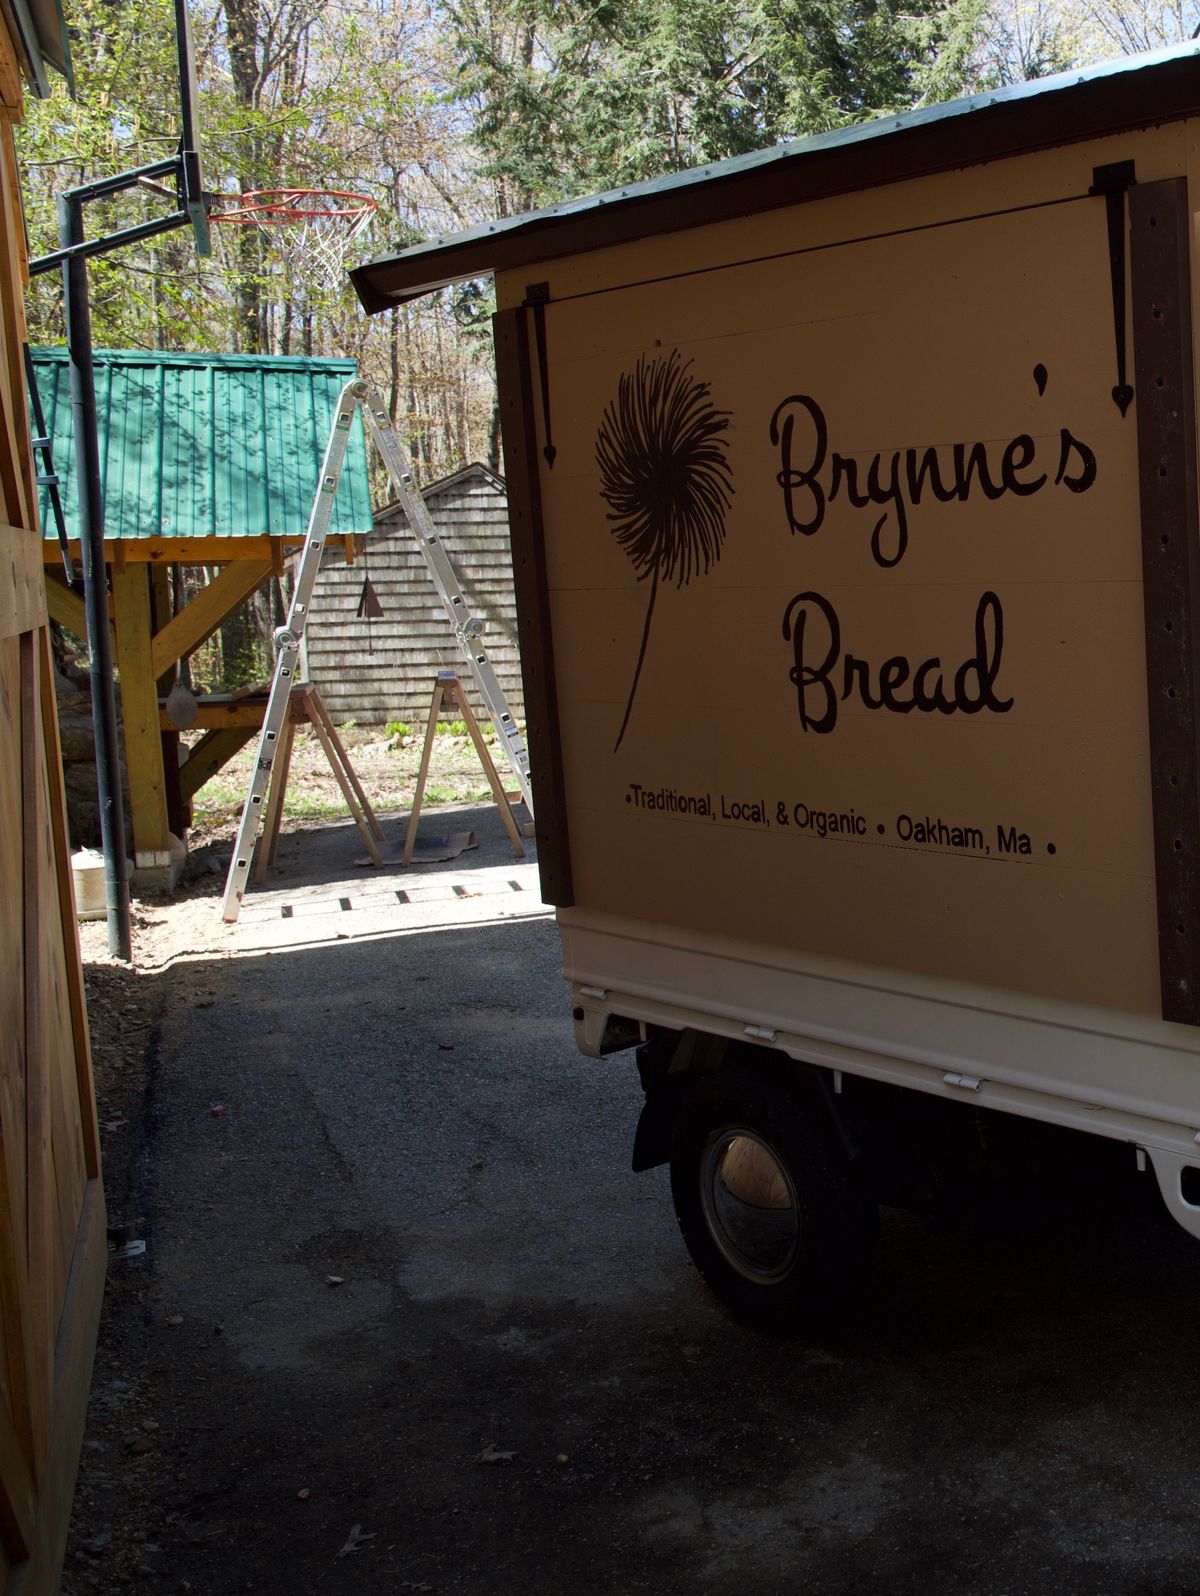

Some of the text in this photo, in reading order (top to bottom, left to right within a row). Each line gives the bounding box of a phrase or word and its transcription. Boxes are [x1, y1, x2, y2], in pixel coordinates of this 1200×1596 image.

[769, 363, 1098, 568] Brynne's
[782, 590, 1015, 734] Bread
[629, 783, 1033, 856] Traditional, Local, & Organic Oakham, Ma
